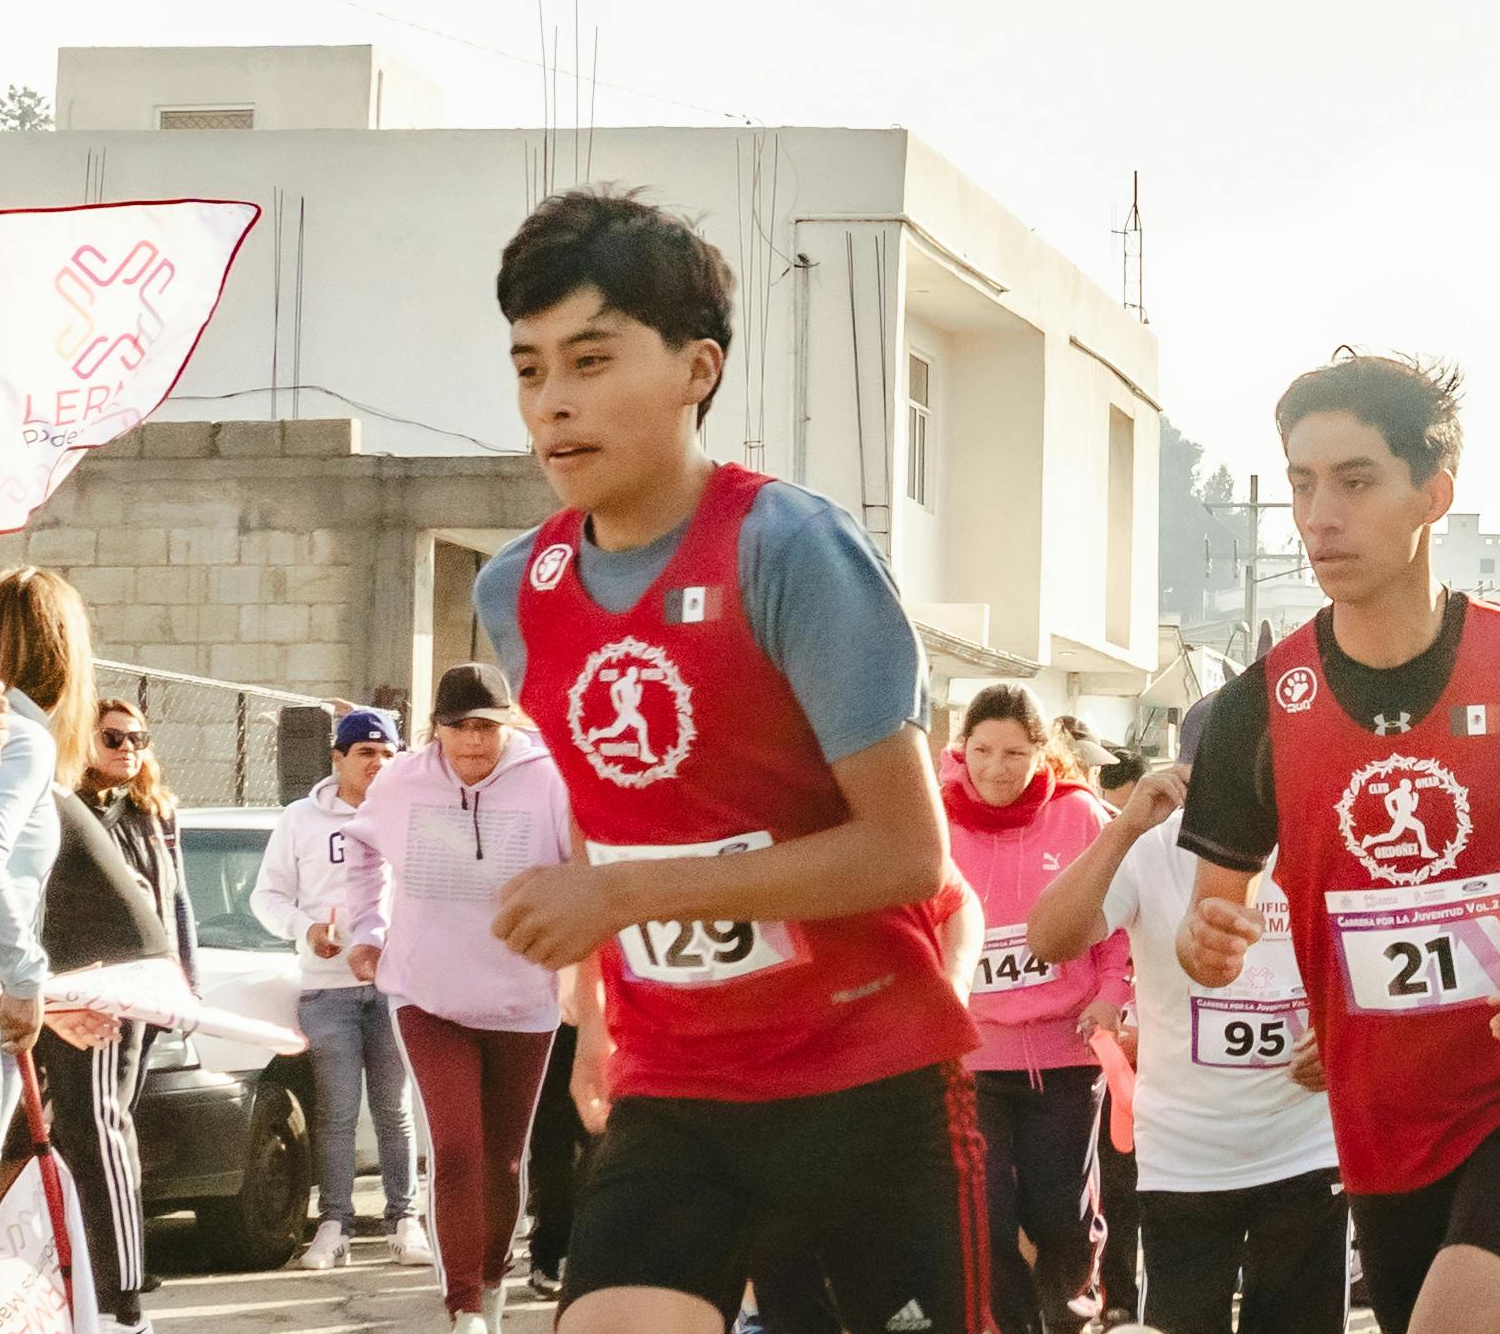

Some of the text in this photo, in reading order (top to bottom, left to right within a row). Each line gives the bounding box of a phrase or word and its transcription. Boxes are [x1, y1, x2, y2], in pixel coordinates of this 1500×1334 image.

[22, 380, 124, 427] LER
[329, 830, 346, 865] G
[1256, 902, 1289, 913] UFID
[637, 918, 755, 968] 129
[977, 953, 1050, 985] 144
[1382, 936, 1458, 997] 21
[1224, 1020, 1285, 1057] 95
